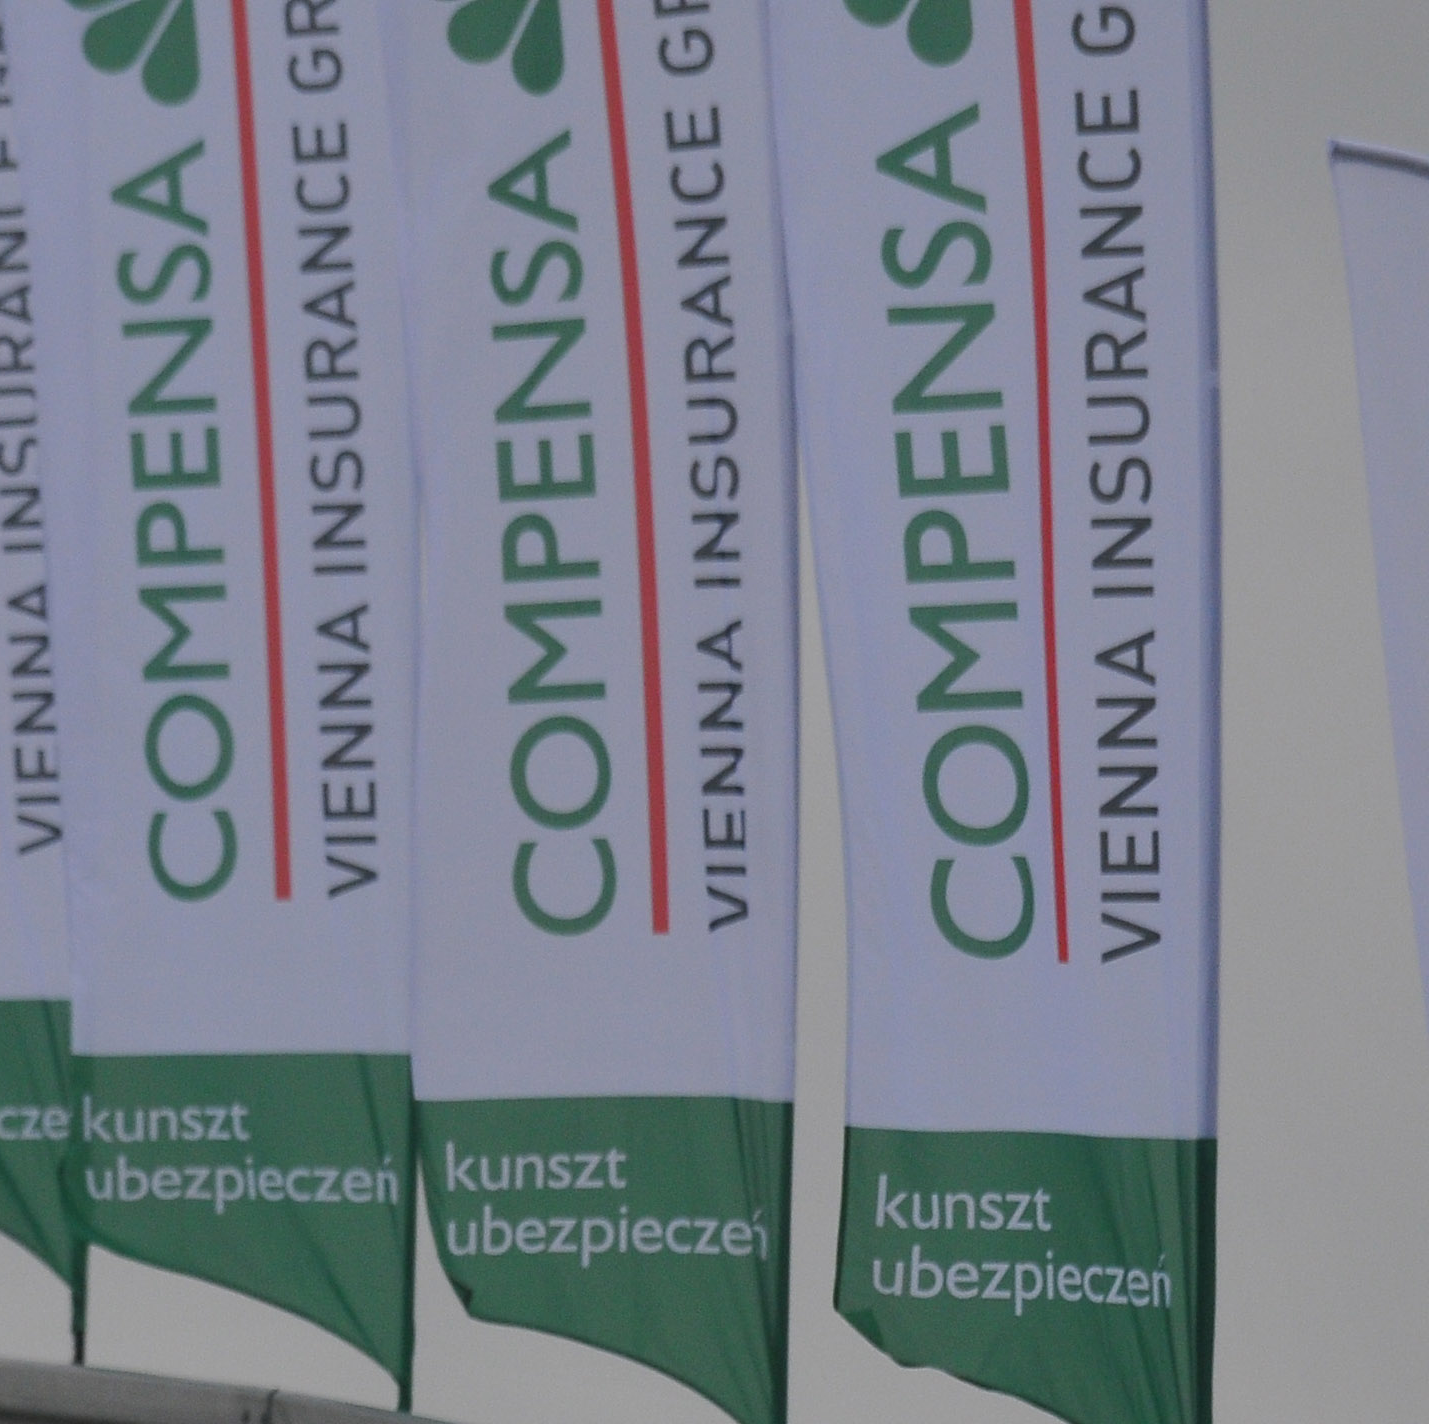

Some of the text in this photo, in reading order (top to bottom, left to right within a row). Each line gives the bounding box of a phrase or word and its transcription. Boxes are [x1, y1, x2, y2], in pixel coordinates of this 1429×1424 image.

[290, 122, 369, 577] INSURANCE
[663, 104, 741, 590] INSURANCE
[1073, 86, 1156, 601] INSURANCE
[109, 138, 239, 901] COMPENSA
[486, 128, 619, 938] COMPENSA
[875, 101, 1036, 962] COMPENSA
[315, 601, 380, 899] VIENNA
[695, 619, 750, 934] VIENNA
[1093, 628, 1165, 966] VIENNA
[82, 1095, 250, 1143] kunszt
[85, 1154, 399, 1215] ubezpieczeń
[444, 1140, 627, 1192] kunszt
[446, 1204, 768, 1269] ubezpieczeń
[875, 1174, 1052, 1233] kunszt
[871, 1244, 1173, 1316] ubezpieczeń
